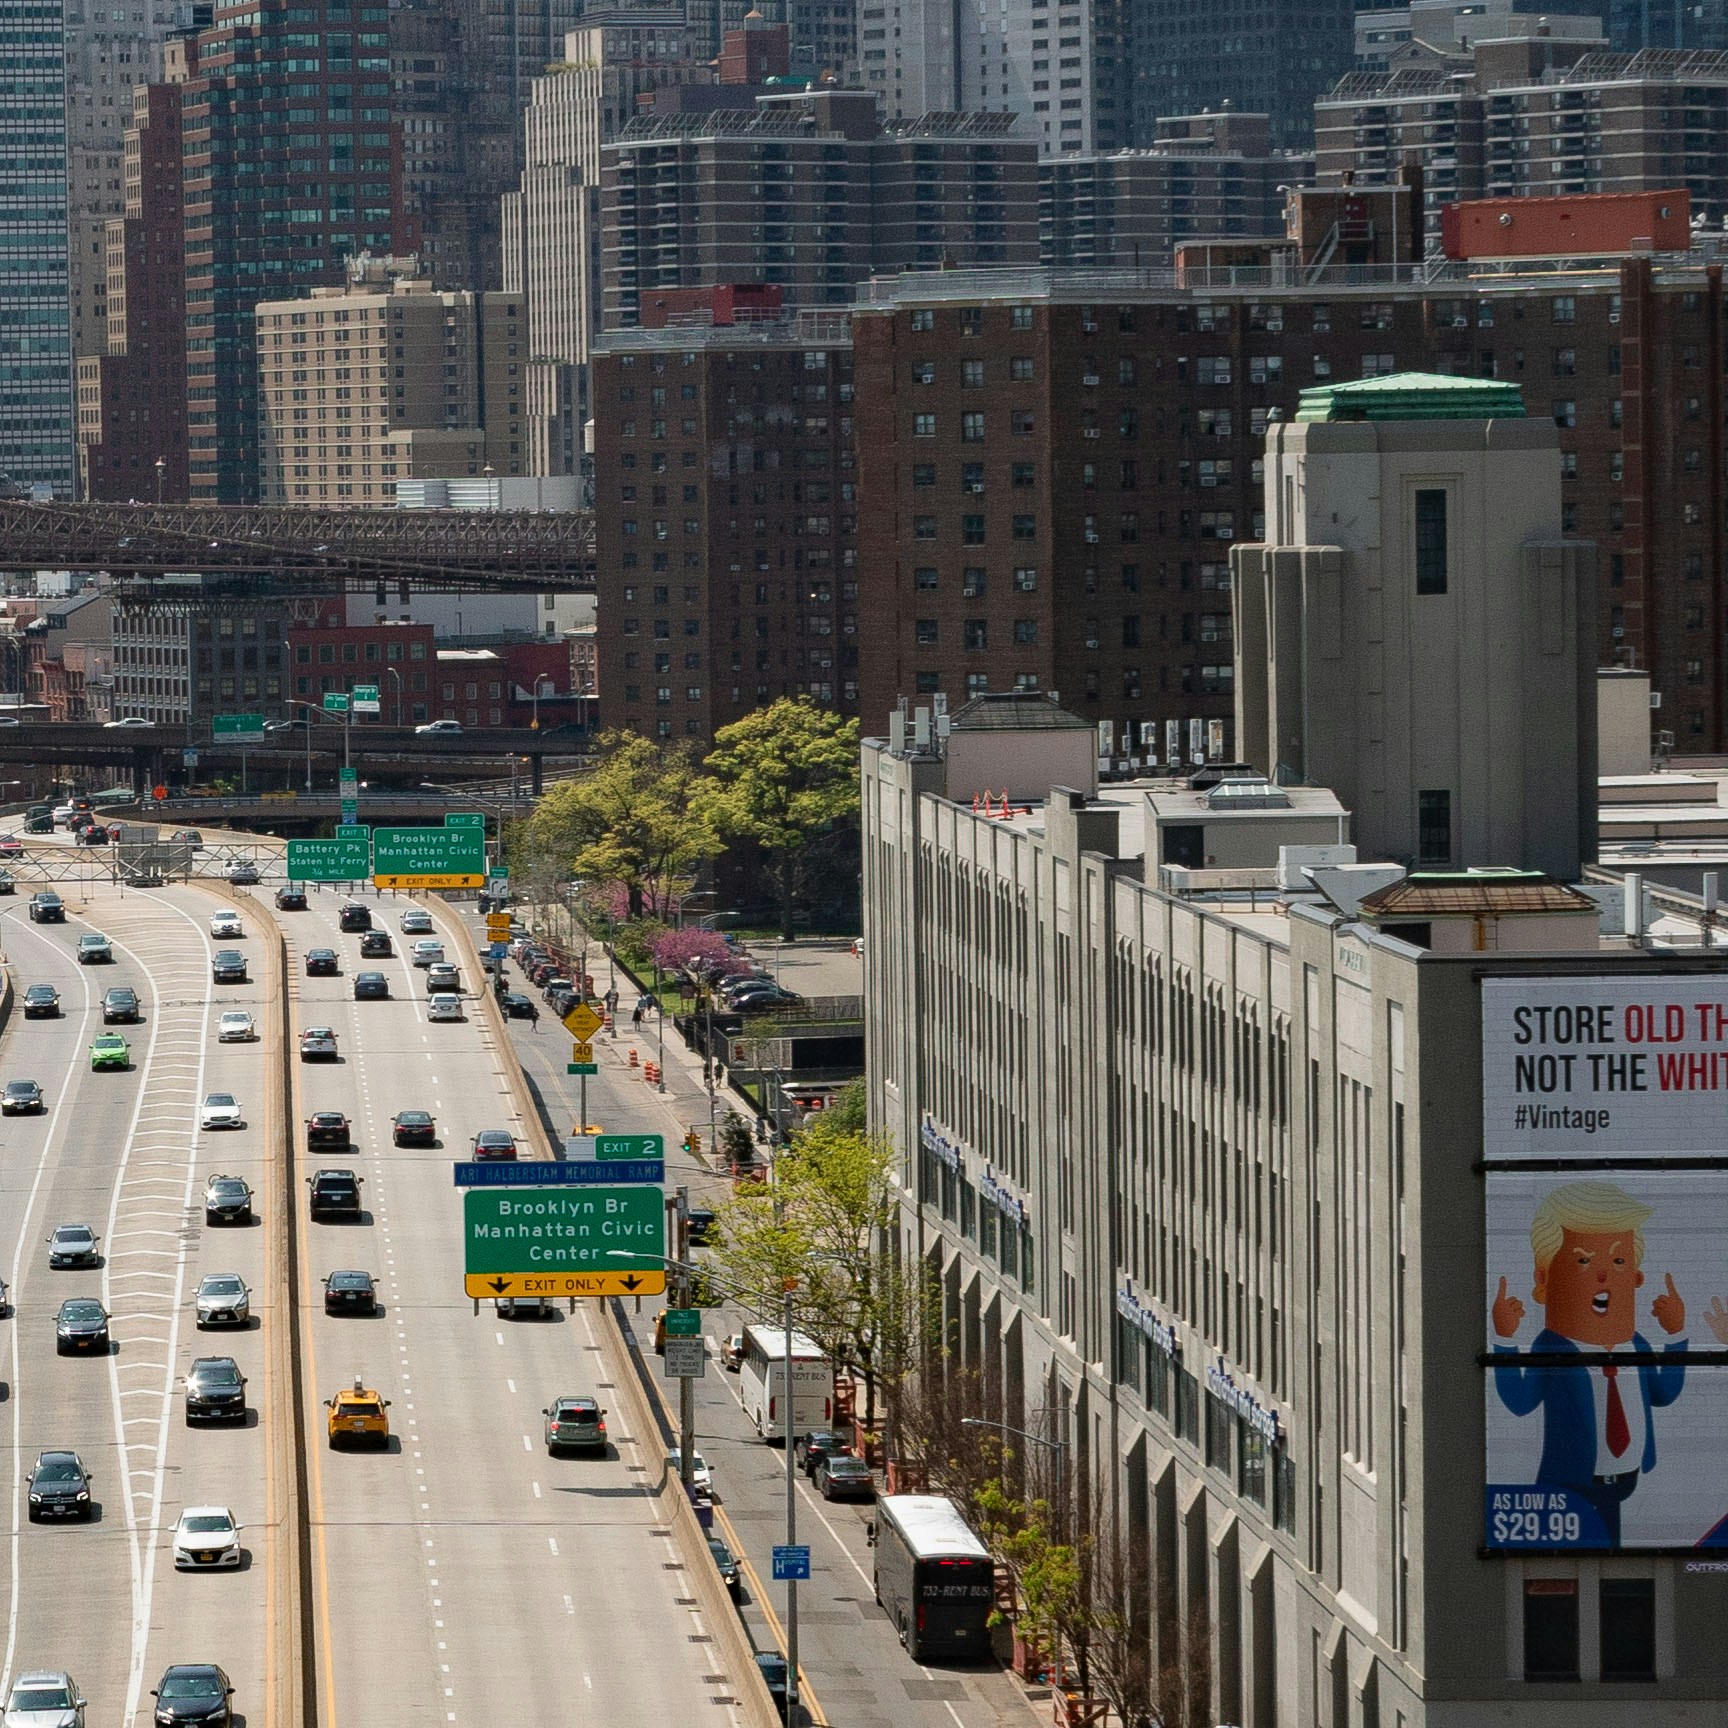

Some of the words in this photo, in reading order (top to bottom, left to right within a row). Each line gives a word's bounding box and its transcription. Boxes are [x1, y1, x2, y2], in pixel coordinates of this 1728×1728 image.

[471, 816, 479, 825] 2
[362, 828, 367, 836] 1
[393, 834, 446, 846] Brooklyn
[451, 834, 464, 843] Br
[295, 844, 340, 855] Battery
[346, 844, 361, 853] Pk
[379, 847, 443, 856] Manhattan
[449, 846, 479, 855] Civic
[290, 857, 323, 865] Staten
[327, 857, 335, 865] Is
[340, 857, 366, 866] Ferry
[409, 859, 448, 869] Center
[428, 877, 452, 885] ONLY
[1513, 1005, 1615, 1044] STORE
[1624, 1004, 1685, 1043] OLD
[575, 1046, 590, 1056] 40
[1515, 1054, 1577, 1093] NOT
[1586, 1053, 1648, 1092] THE
[1514, 1103, 1610, 1133] #Vintage
[603, 1142, 630, 1153] EXIT
[642, 1140, 657, 1154] 2
[460, 1167, 479, 1181] ARI
[486, 1166, 558, 1181] HALBERSTAM
[565, 1165, 620, 1180] MEMORIAL
[628, 1165, 659, 1179] RAMP
[499, 1199, 594, 1217] Brooklyn
[605, 1198, 628, 1213] Br
[474, 1222, 590, 1238] Manhattan
[601, 1221, 655, 1235] Civic
[529, 1245, 600, 1260] Center
[524, 1279, 557, 1291] EXIT
[565, 1278, 606, 1290] ONLY
[1493, 1493, 1511, 1510] AS
[1515, 1493, 1544, 1510] LOW
[1548, 1493, 1567, 1510] AS
[1493, 1511, 1580, 1543] $29.99
